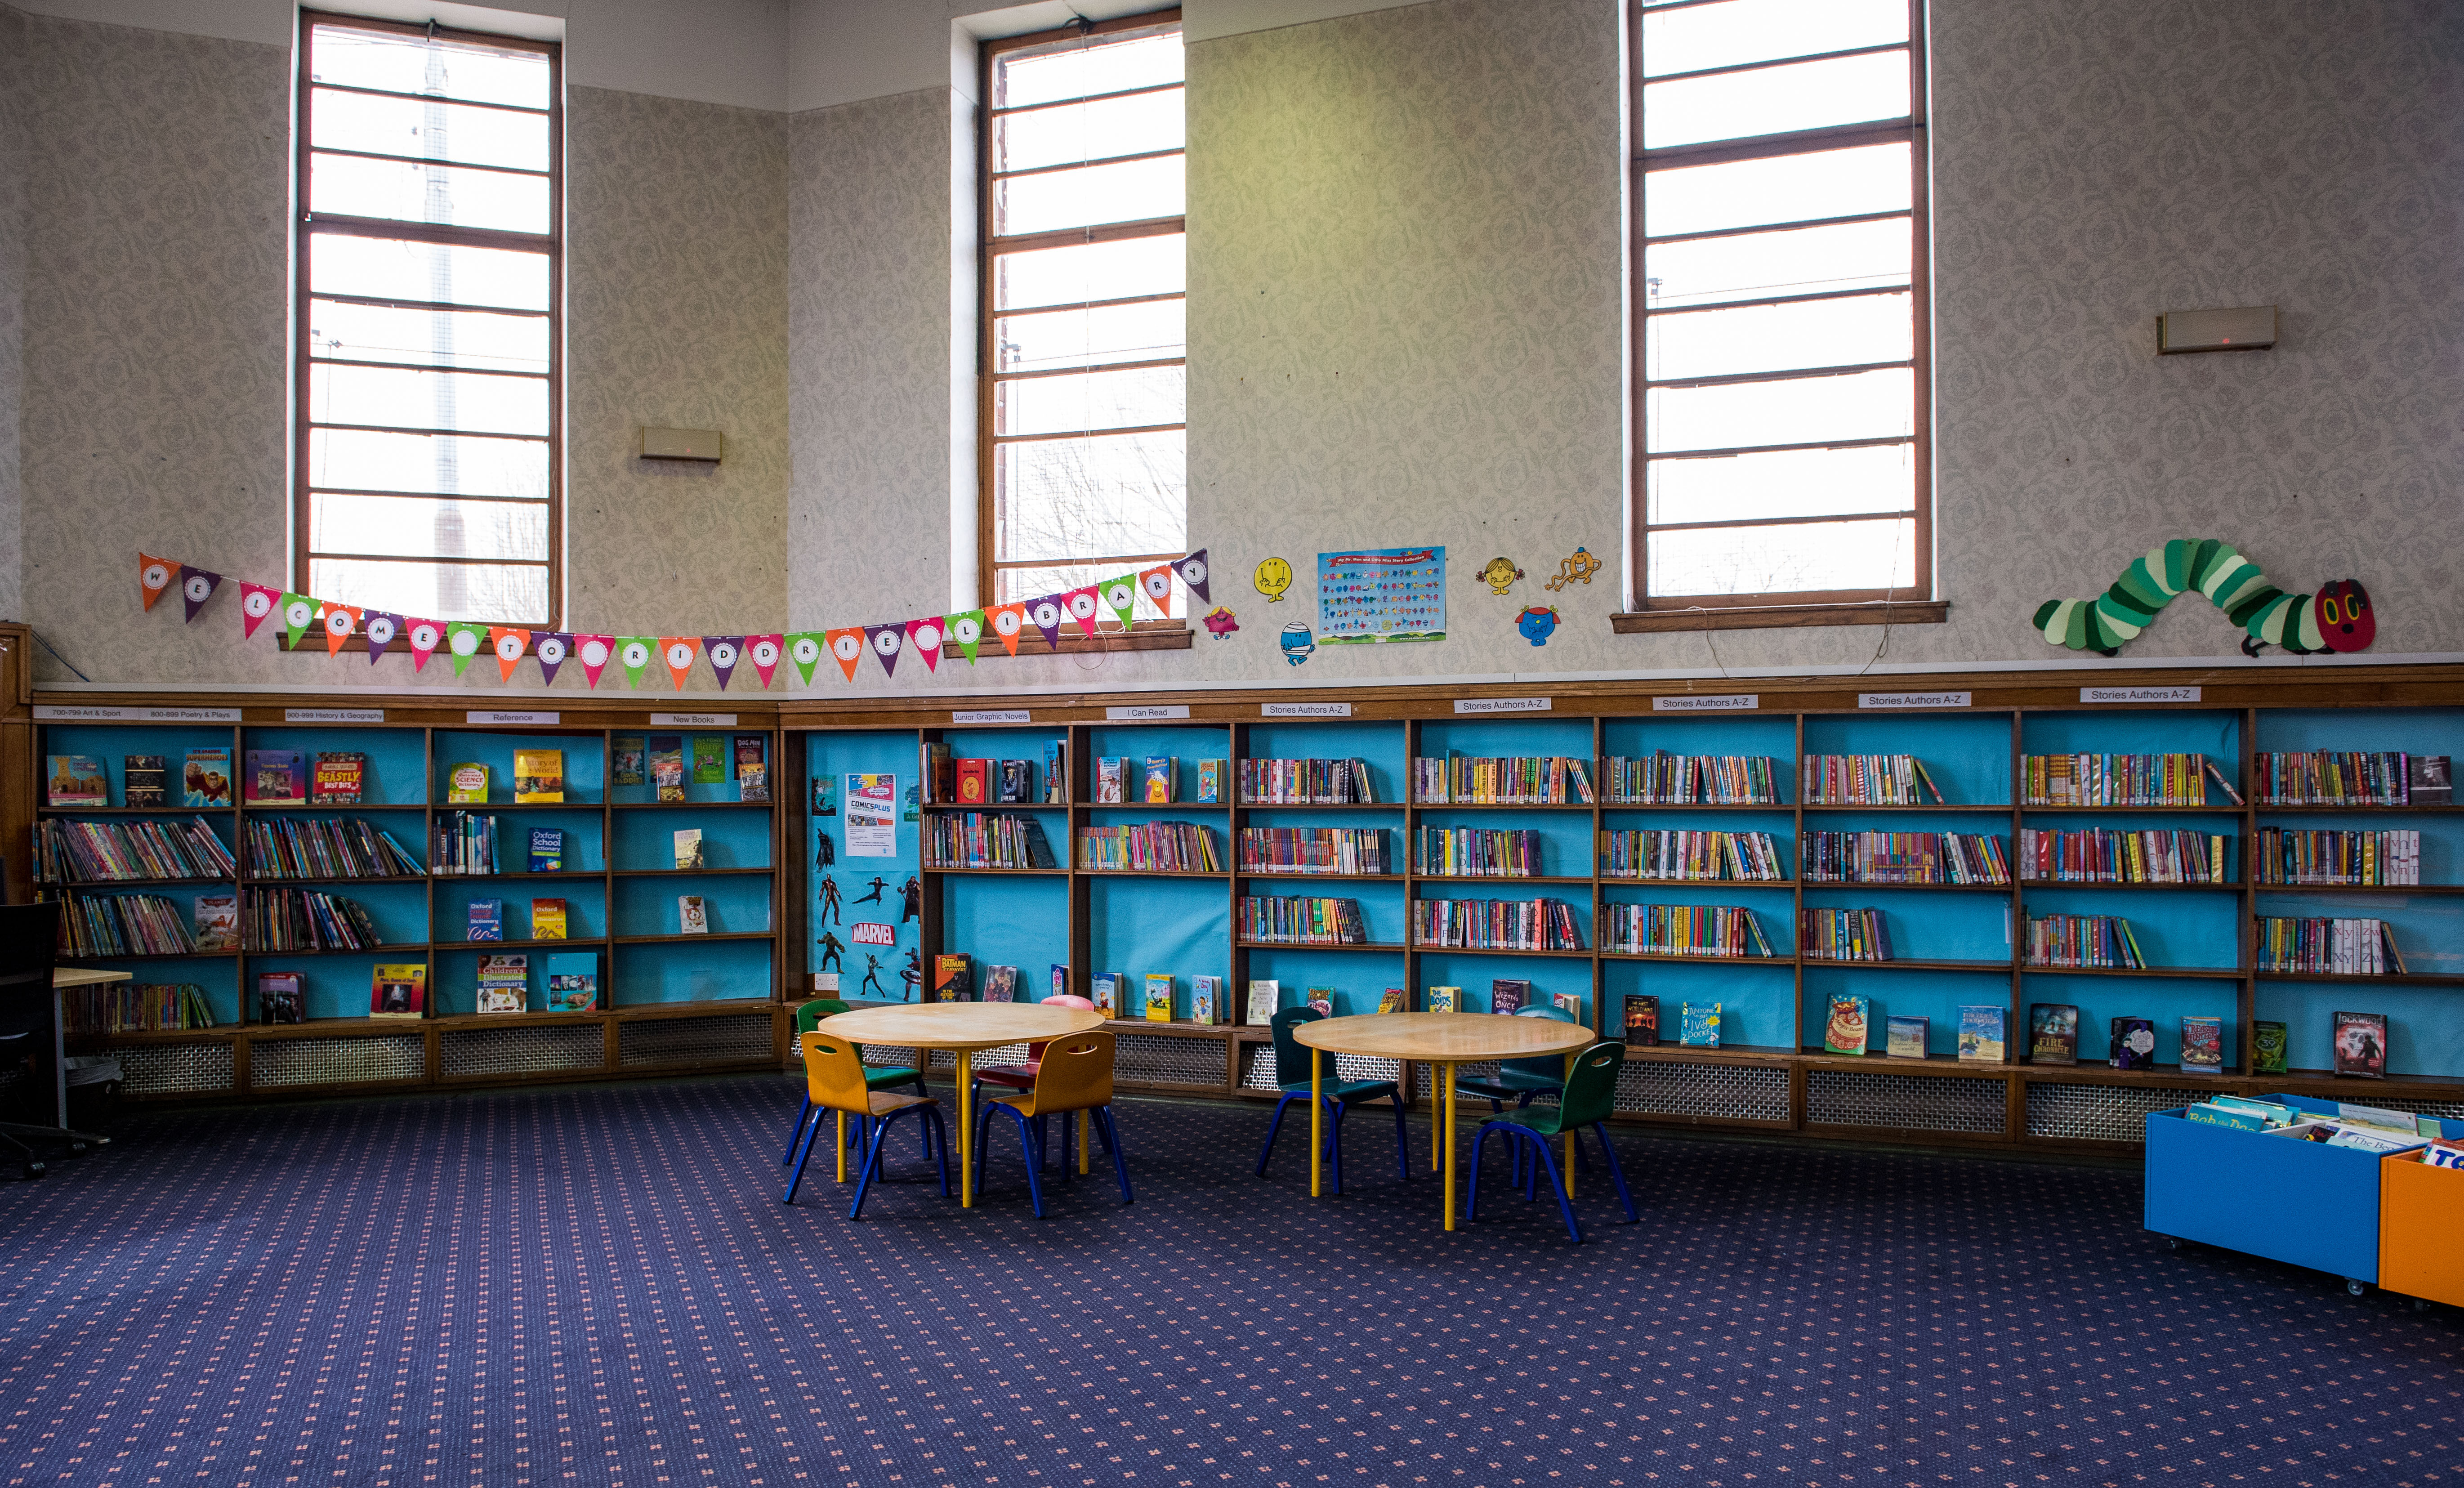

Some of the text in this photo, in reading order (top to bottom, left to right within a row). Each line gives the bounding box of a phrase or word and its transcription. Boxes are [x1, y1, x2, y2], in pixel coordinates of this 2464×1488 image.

[151, 568, 1197, 660] WELCOME TO RIDDRIE LIBRARY
[2091, 690, 2190, 699] Stories Authors A-Z
[1493, 701, 1525, 709] Authors
[1662, 697, 1749, 708] Stories Authors A-Z
[1869, 695, 1961, 706] Stories Authors A-Z
[1270, 706, 1343, 714] Stories Authors A-Z
[976, 713, 1002, 721] Graphic
[1677, 761, 1683, 770] h
[2082, 764, 2090, 774] p
[317, 772, 360, 783] BEASTLY
[660, 773, 681, 782] TEAM
[533, 838, 560, 846] School
[1460, 833, 1466, 843] d
[1664, 836, 1667, 846] i
[1680, 836, 1684, 848] j
[1752, 838, 1759, 848] k
[2414, 838, 2418, 848] t
[1442, 906, 1448, 916] f
[853, 924, 894, 945] MARVEL
[1415, 929, 1421, 938] E
[942, 958, 966, 968] BATMAN
[1430, 996, 1451, 1007] BOLDS
[1495, 991, 1518, 1002] Wizards
[1689, 1007, 1714, 1017] ANYONE
[1835, 1018, 1848, 1030] Magic
[1688, 1026, 1713, 1040] POCKET
[2039, 1037, 2064, 1047] FIRE
[2262, 1040, 2275, 1048] 39
[2034, 1045, 2069, 1055] CHRONICLE
[2354, 1135, 2370, 1146] The
